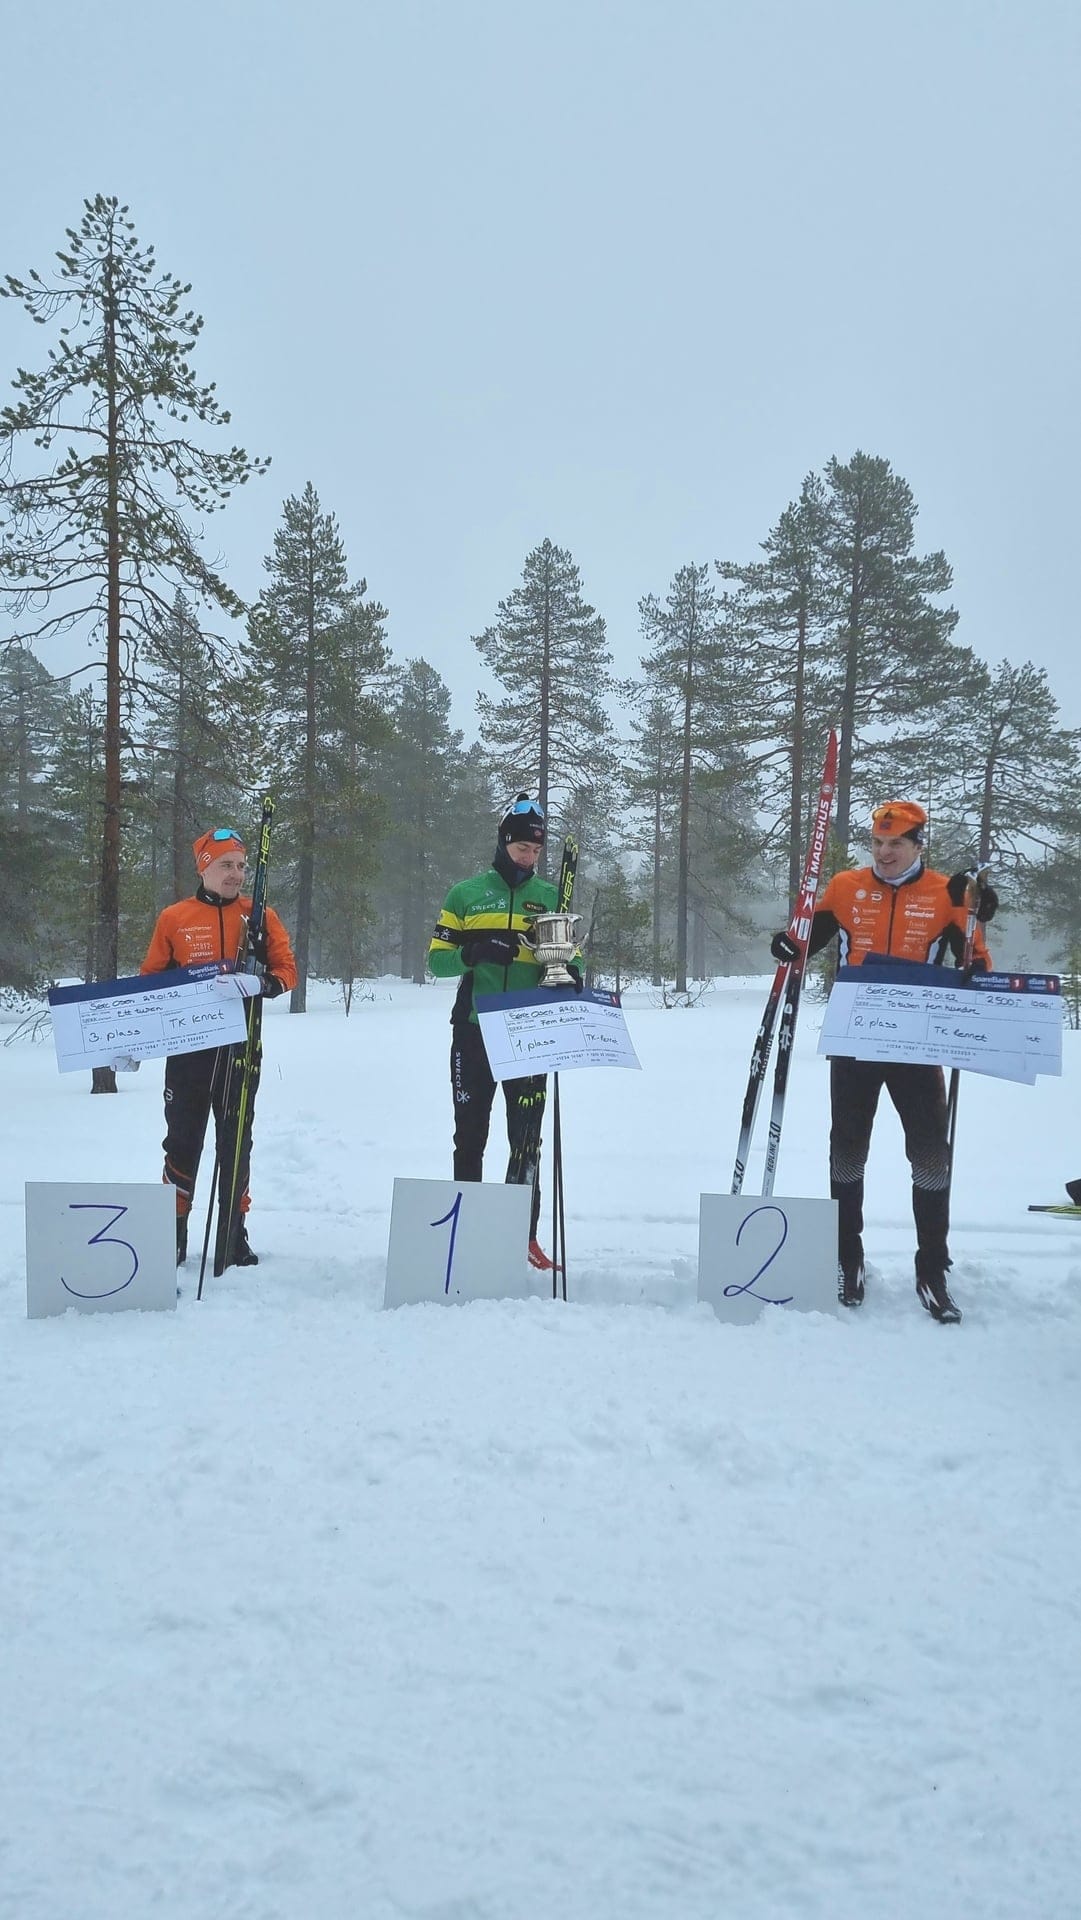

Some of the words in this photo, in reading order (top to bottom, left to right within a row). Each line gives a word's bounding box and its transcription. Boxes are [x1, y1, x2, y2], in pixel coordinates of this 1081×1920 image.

[810, 799, 829, 874] MADSHUS
[187, 964, 220, 976] SpareBank
[971, 975, 1010, 984] SpareBank
[1014, 979, 1020, 987] 1
[169, 1018, 187, 1029] TK
[869, 1017, 898, 1029] plass
[106, 1028, 141, 1041] plass
[934, 1025, 948, 1036] TK
[527, 1038, 556, 1053] plass
[768, 1121, 782, 1143] 3.0
[766, 1143, 777, 1173] REDLINE
[60, 1203, 139, 1299] 3
[722, 1205, 794, 1306] 2
